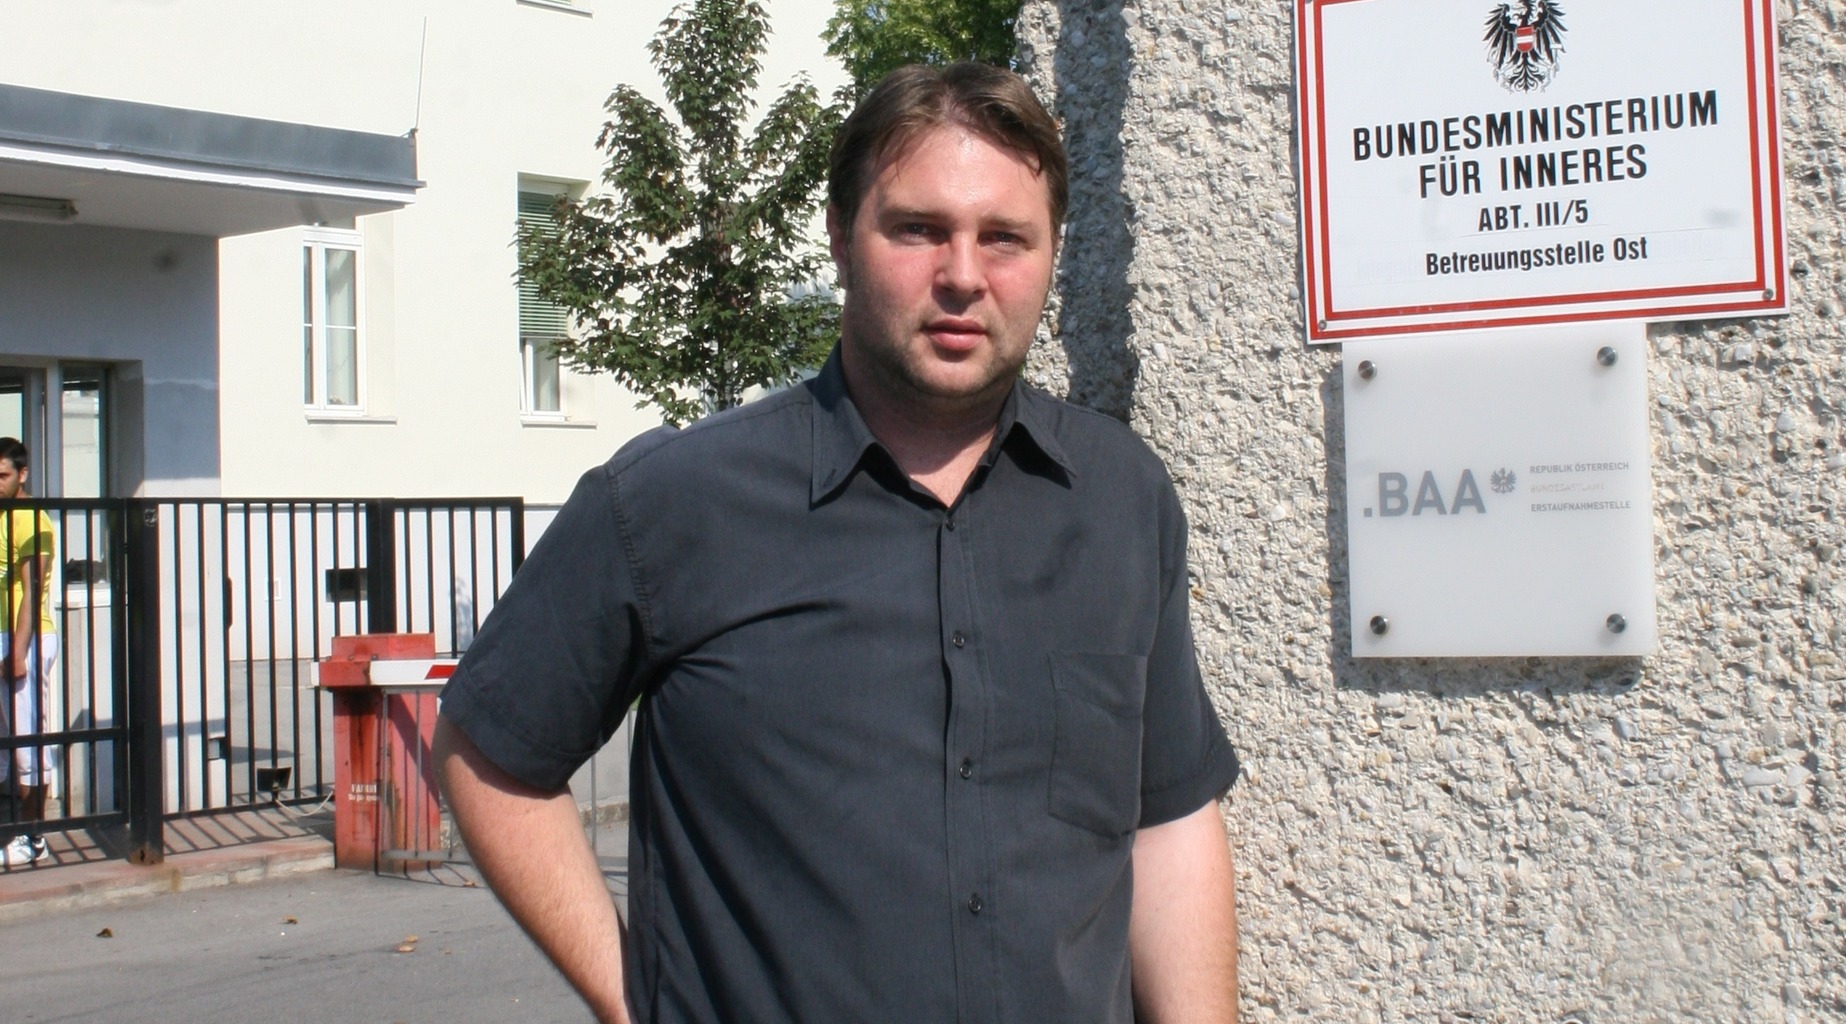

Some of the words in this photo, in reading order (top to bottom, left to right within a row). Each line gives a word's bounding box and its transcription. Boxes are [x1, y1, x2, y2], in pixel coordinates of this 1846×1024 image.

[1353, 89, 1718, 162] BUNDESMINISTERIUM
[1419, 154, 1482, 199] FÜR
[1500, 143, 1648, 192] INNERES
[1478, 204, 1529, 232] ABT.
[1536, 198, 1589, 227] III/5
[1425, 239, 1605, 276] Betreuungsstelle
[1613, 236, 1648, 261] Ost
[1530, 464, 1573, 474] REPUBLIK
[1574, 461, 1630, 472] ÖSTERREICH
[1531, 501, 1631, 512] ERSTAUFNAHMESTELLE
